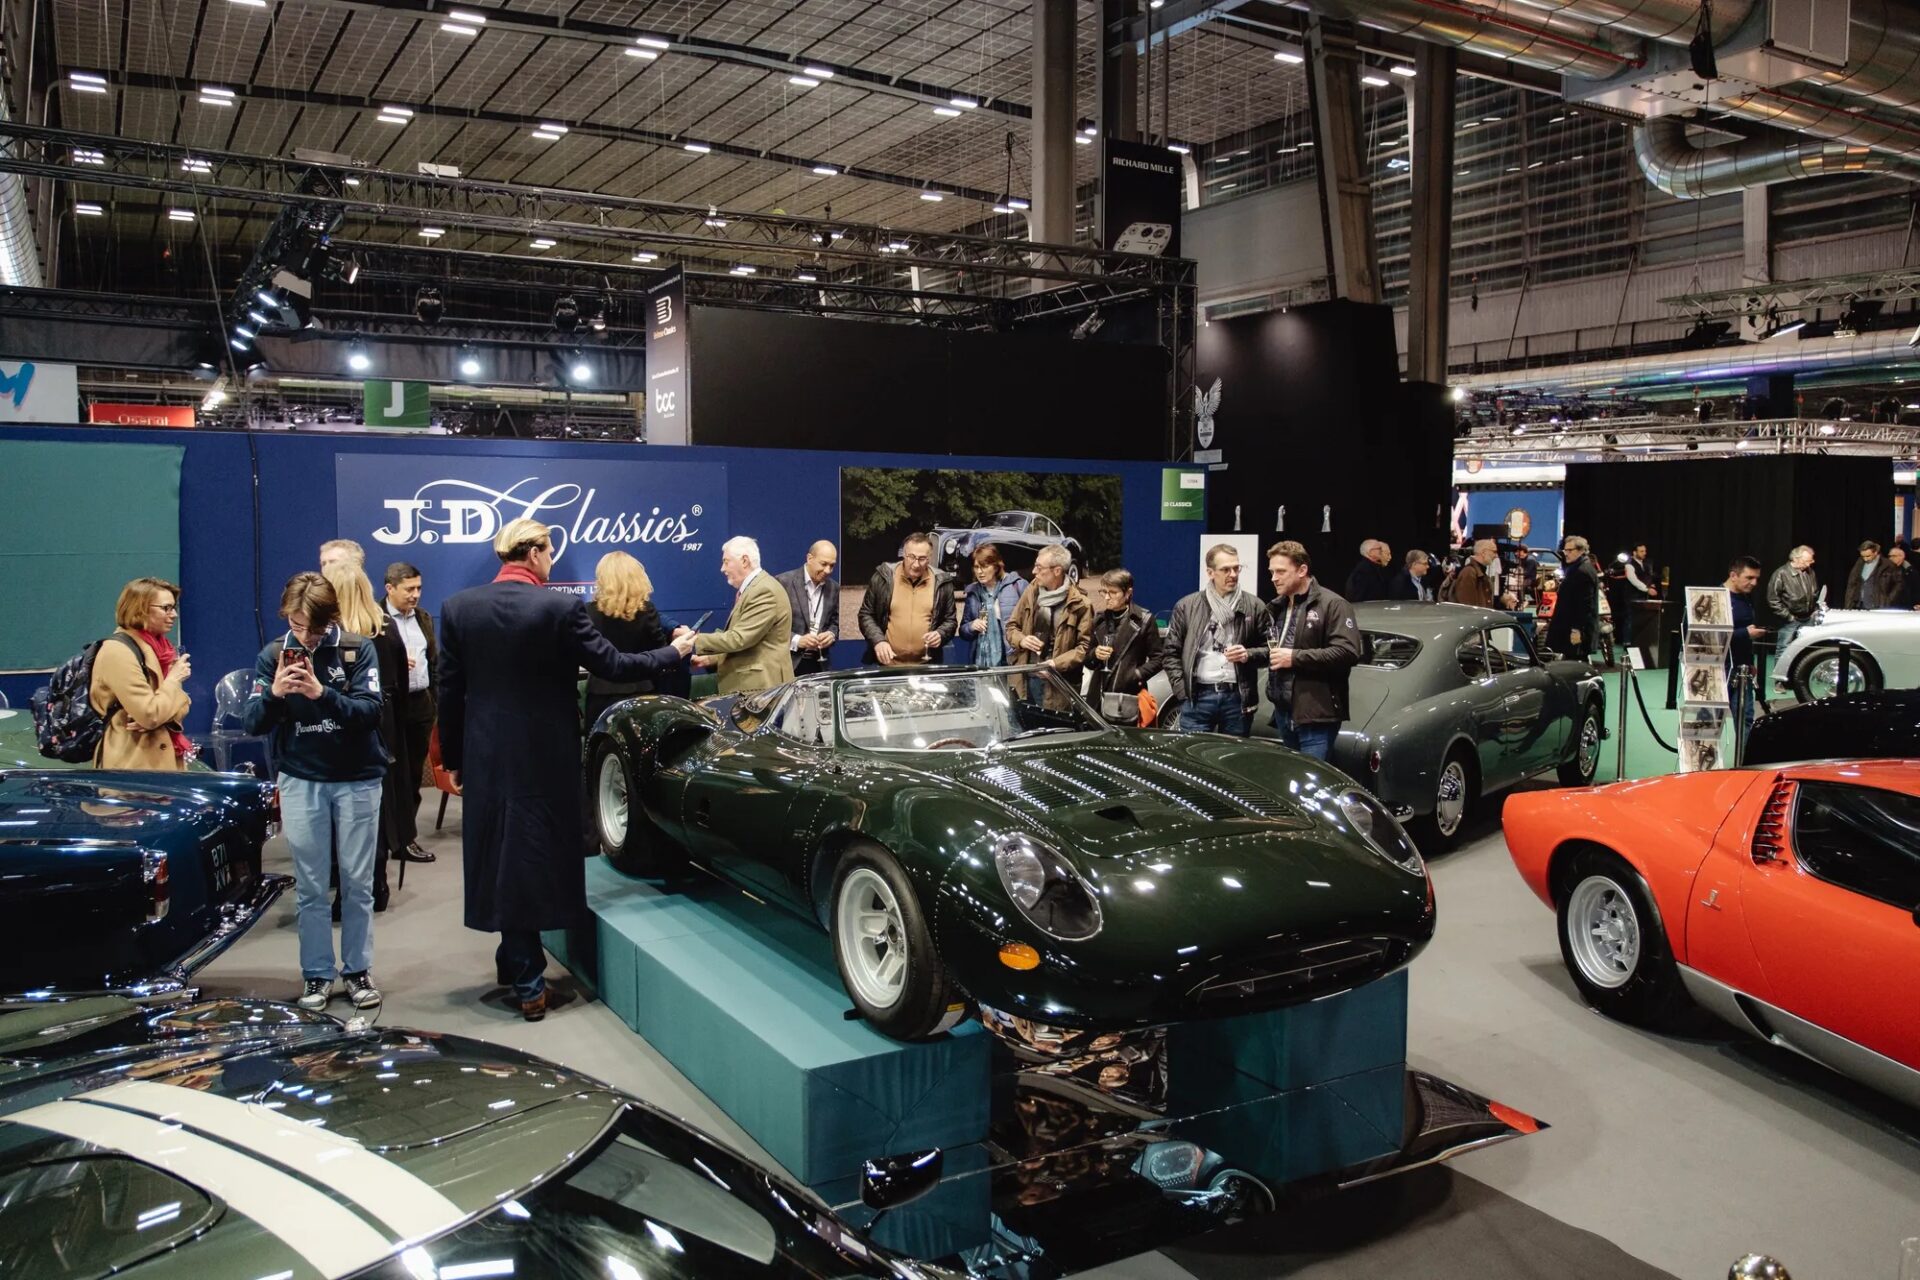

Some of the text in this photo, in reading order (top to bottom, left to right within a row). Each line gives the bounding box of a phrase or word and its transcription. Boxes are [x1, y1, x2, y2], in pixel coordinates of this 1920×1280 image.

[1112, 157, 1175, 174] RICHARD MILLE
[383, 381, 405, 418] J
[682, 542, 703, 552] 1987
[547, 585, 587, 594] ORTIMER
[367, 667, 380, 692] 3
